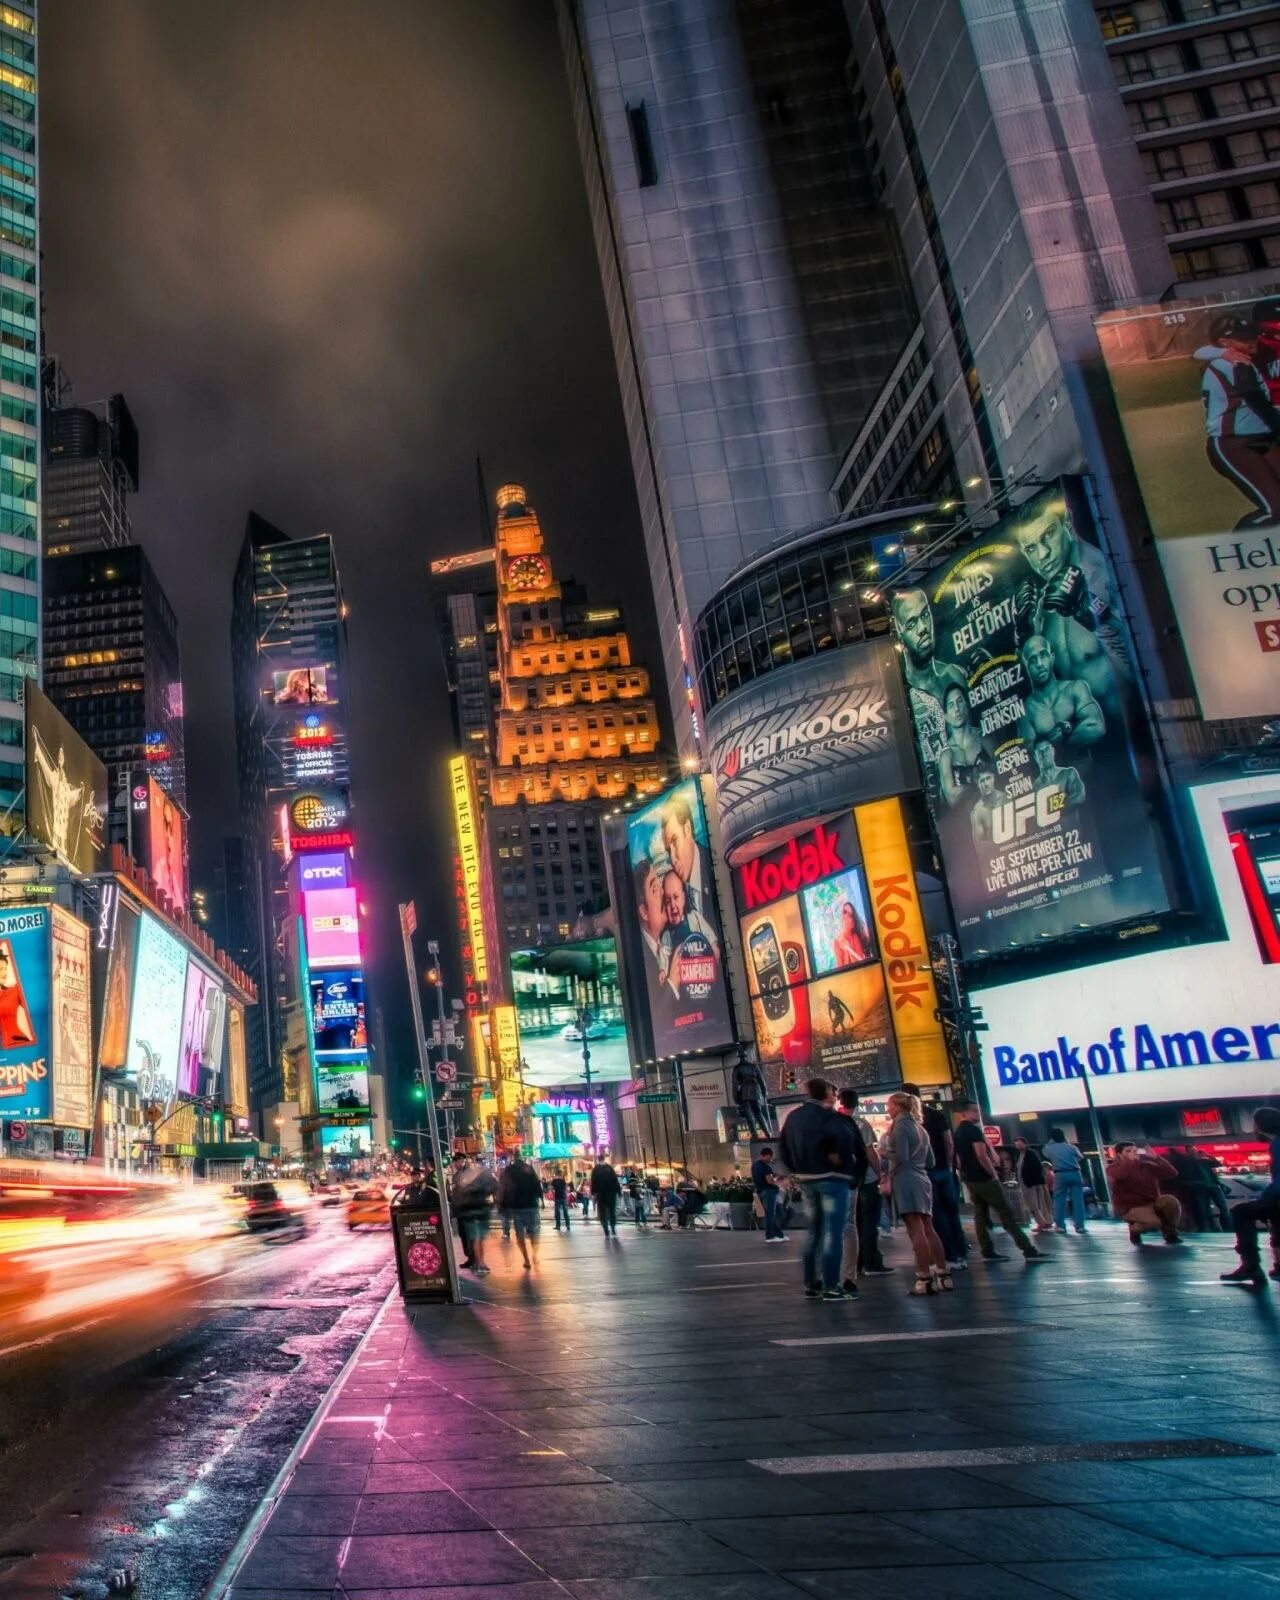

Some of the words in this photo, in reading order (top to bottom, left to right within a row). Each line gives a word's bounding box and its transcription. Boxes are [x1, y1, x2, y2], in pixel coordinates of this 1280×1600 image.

[953, 570, 993, 608] JONES
[1060, 566, 1080, 594] UFC
[967, 602, 991, 621] VITOR
[952, 598, 1011, 655] BELFORT
[968, 664, 1024, 709] BENAVIDEZ
[980, 699, 1026, 737] JOHNSON
[295, 751, 333, 760] TOSHIBA
[760, 743, 806, 771] driving
[810, 726, 888, 753] emotion
[996, 749, 1029, 775] BISPING
[452, 765, 466, 793] THE
[1005, 776, 1033, 799] STANN
[134, 801, 147, 810] LG
[458, 801, 471, 834] NEW
[992, 784, 1062, 844] UFC
[1048, 793, 1066, 812] 152
[307, 818, 339, 829] 2012
[291, 833, 352, 849] TOSHIBA
[1008, 835, 1065, 868] SEPTEMBER
[1067, 829, 1081, 848] 22
[311, 867, 343, 878] TDK
[463, 844, 477, 874] HTC
[740, 824, 846, 909] Kodak
[986, 874, 1007, 892] LIVE
[1007, 869, 1021, 886] ON
[1022, 842, 1092, 881] PAY-PER-VIEW
[26, 885, 54, 894] LAMAR
[468, 882, 482, 910] EVO
[7, 913, 44, 932] MORE!
[687, 941, 704, 954] WILL
[873, 873, 930, 1011] Kodak
[475, 948, 488, 975] LTE
[680, 963, 714, 982] CAMPAIGN
[689, 983, 708, 995] ZACH
[993, 1035, 1084, 1086] Bank
[1087, 1026, 1127, 1076] of
[329, 1074, 356, 1085] FRINGE
